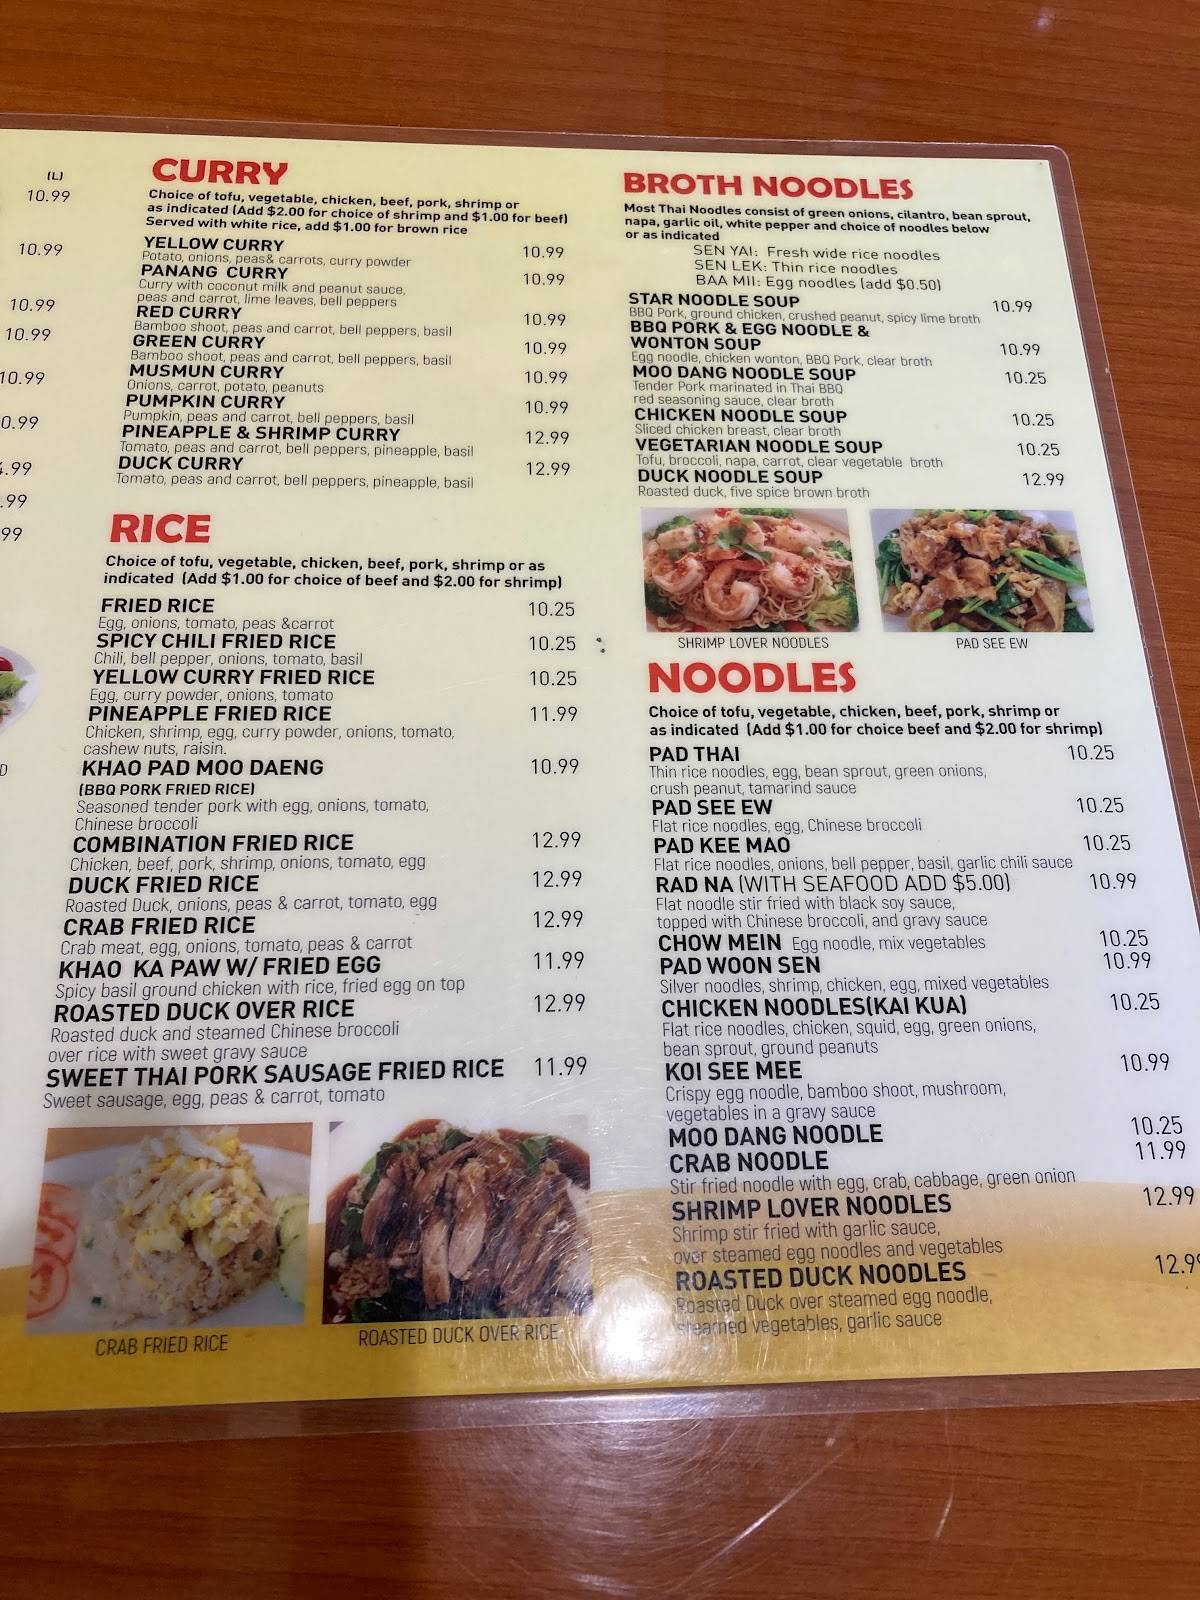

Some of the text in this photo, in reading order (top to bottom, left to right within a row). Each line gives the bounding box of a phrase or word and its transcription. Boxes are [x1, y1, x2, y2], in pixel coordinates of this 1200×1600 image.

[47, 172, 63, 181] (L)
[152, 158, 288, 185] CURRY
[624, 173, 913, 200] BROTH NOODLES
[28, 190, 70, 202] 10.99
[146, 217, 467, 234] Served with white rice, add $1.00 for brown rice
[625, 230, 719, 240] or as indicated
[20, 243, 62, 256] 10.99
[144, 236, 284, 251] YELLOW CURRY
[142, 251, 184, 263] Potato,
[189, 252, 231, 264] onions,
[330, 258, 362, 268] curry
[366, 257, 411, 268] powder
[523, 246, 563, 258] 10.99
[141, 265, 288, 279] PANANG CURRY
[695, 260, 898, 275] SEN LEK: Thin rice noodles
[524, 273, 564, 285] 10.99
[11, 299, 55, 311] 10.99
[629, 293, 799, 308] STAR NOODLE SOUP
[993, 300, 1032, 312] 10.99
[137, 306, 242, 319] RED CURRY
[524, 313, 565, 326] 10.99
[6, 328, 50, 341] 10.99
[133, 335, 265, 349] GREEN CURRY
[525, 342, 566, 354] 10.99
[130, 365, 284, 378] MUSMUN CURRY
[525, 371, 567, 384] 10.99
[633, 365, 856, 381] MOO DANG NOODLE SOUP
[1005, 372, 1046, 384] 10.25
[128, 380, 325, 395] Onions, carrot, potato, peanuts
[122, 426, 400, 441] PINEAPPLE & SHRIMP CURRY
[526, 431, 569, 444] 12.99
[119, 457, 243, 470] DUCK CURRY
[527, 462, 570, 476] 12.99
[638, 470, 822, 483] DUCK NOODLE SOUP
[1023, 473, 1064, 486] 12.99
[638, 486, 869, 499] Roasted duck, five spice brown broth
[110, 514, 210, 543] RICE
[102, 598, 214, 613] FRIED RICE
[529, 602, 574, 616] 10.25
[99, 616, 126, 631] Egg,
[131, 616, 181, 631] onions,
[185, 617, 237, 631] tomato,
[243, 619, 276, 632] peas
[678, 637, 829, 648] SHRIMP LOVER NOODLES
[956, 638, 1027, 649] PAD SEE EW
[649, 662, 856, 693] NOODLES
[89, 706, 331, 721] PINEAPPLE FRIED RICE
[531, 706, 577, 721] 11.99
[650, 747, 739, 761] PAD THAI
[1068, 745, 1114, 760] 10.25
[79, 782, 254, 796] (BBQ PORK FRIED RICE)
[651, 782, 856, 797] crush peanut, tamarind sauce
[655, 837, 790, 853] PAD KEE MAO
[1084, 835, 1130, 851] 10.25
[69, 875, 259, 894] DUCK FRIED RICE
[533, 871, 582, 887] 12.99
[64, 916, 255, 936] CRAB FRIED RICE
[534, 911, 583, 928] 12.99
[659, 934, 985, 953] CHOW MEIN Egg noodle, mix vegetables
[1100, 930, 1148, 947] 10.25
[1121, 1053, 1169, 1071] 10.99
[666, 1061, 802, 1081] KOI SEE MEE
[43, 1088, 384, 1109] Sweet sausage, egg, peas & carrot, tomato
[1136, 1141, 1185, 1160] 11.99
[670, 1151, 829, 1173] CRAB NOODLE
[1144, 1186, 1194, 1206] 12.99
[672, 1194, 951, 1221] SHRIMP LOVER NOODLES
[96, 1334, 228, 1356] CRAB FRIED RICE
